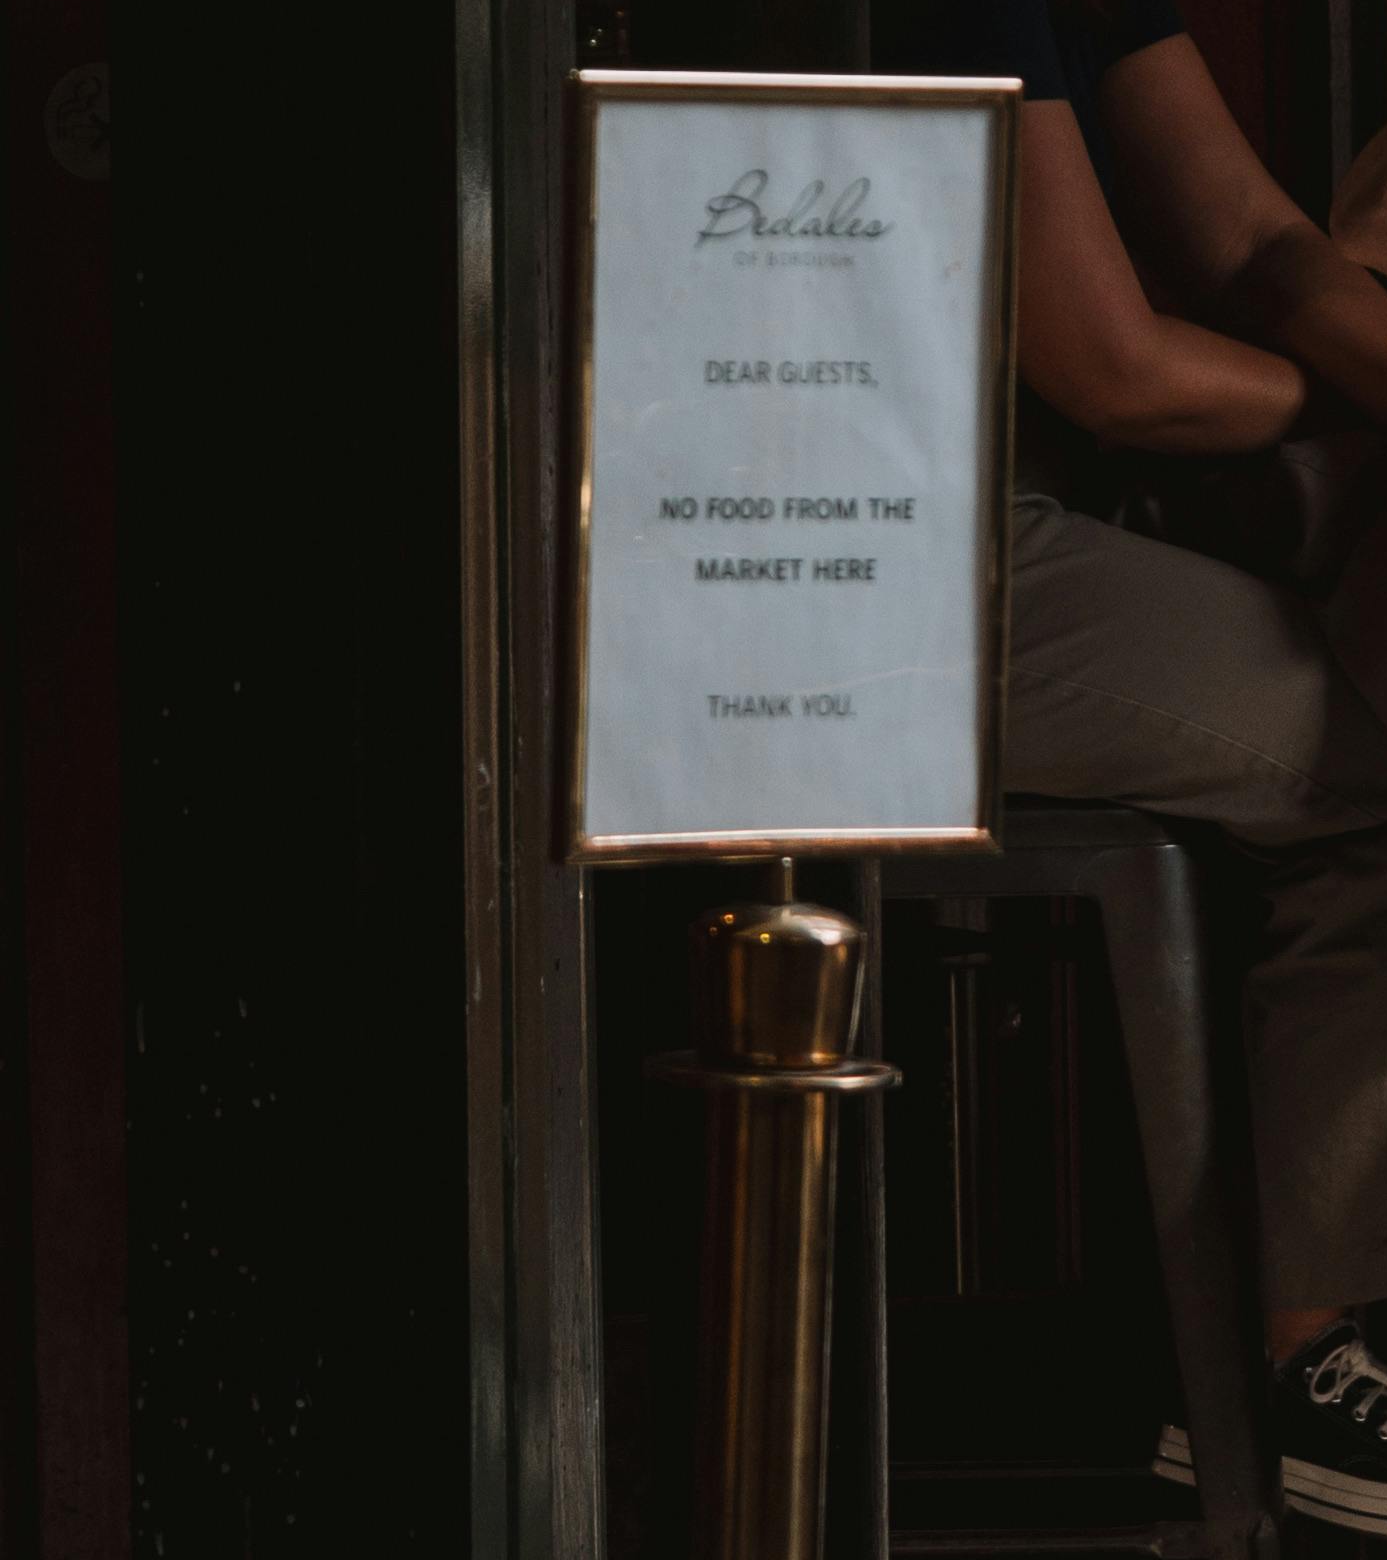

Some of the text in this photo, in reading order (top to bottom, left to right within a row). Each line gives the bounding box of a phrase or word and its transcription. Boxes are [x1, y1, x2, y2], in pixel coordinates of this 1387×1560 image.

[704, 360, 880, 388] DEAR GUESTS,
[659, 497, 916, 520] NO FOOD FROM THE
[694, 558, 877, 581] MARKET HERE
[706, 694, 794, 718] THANK
